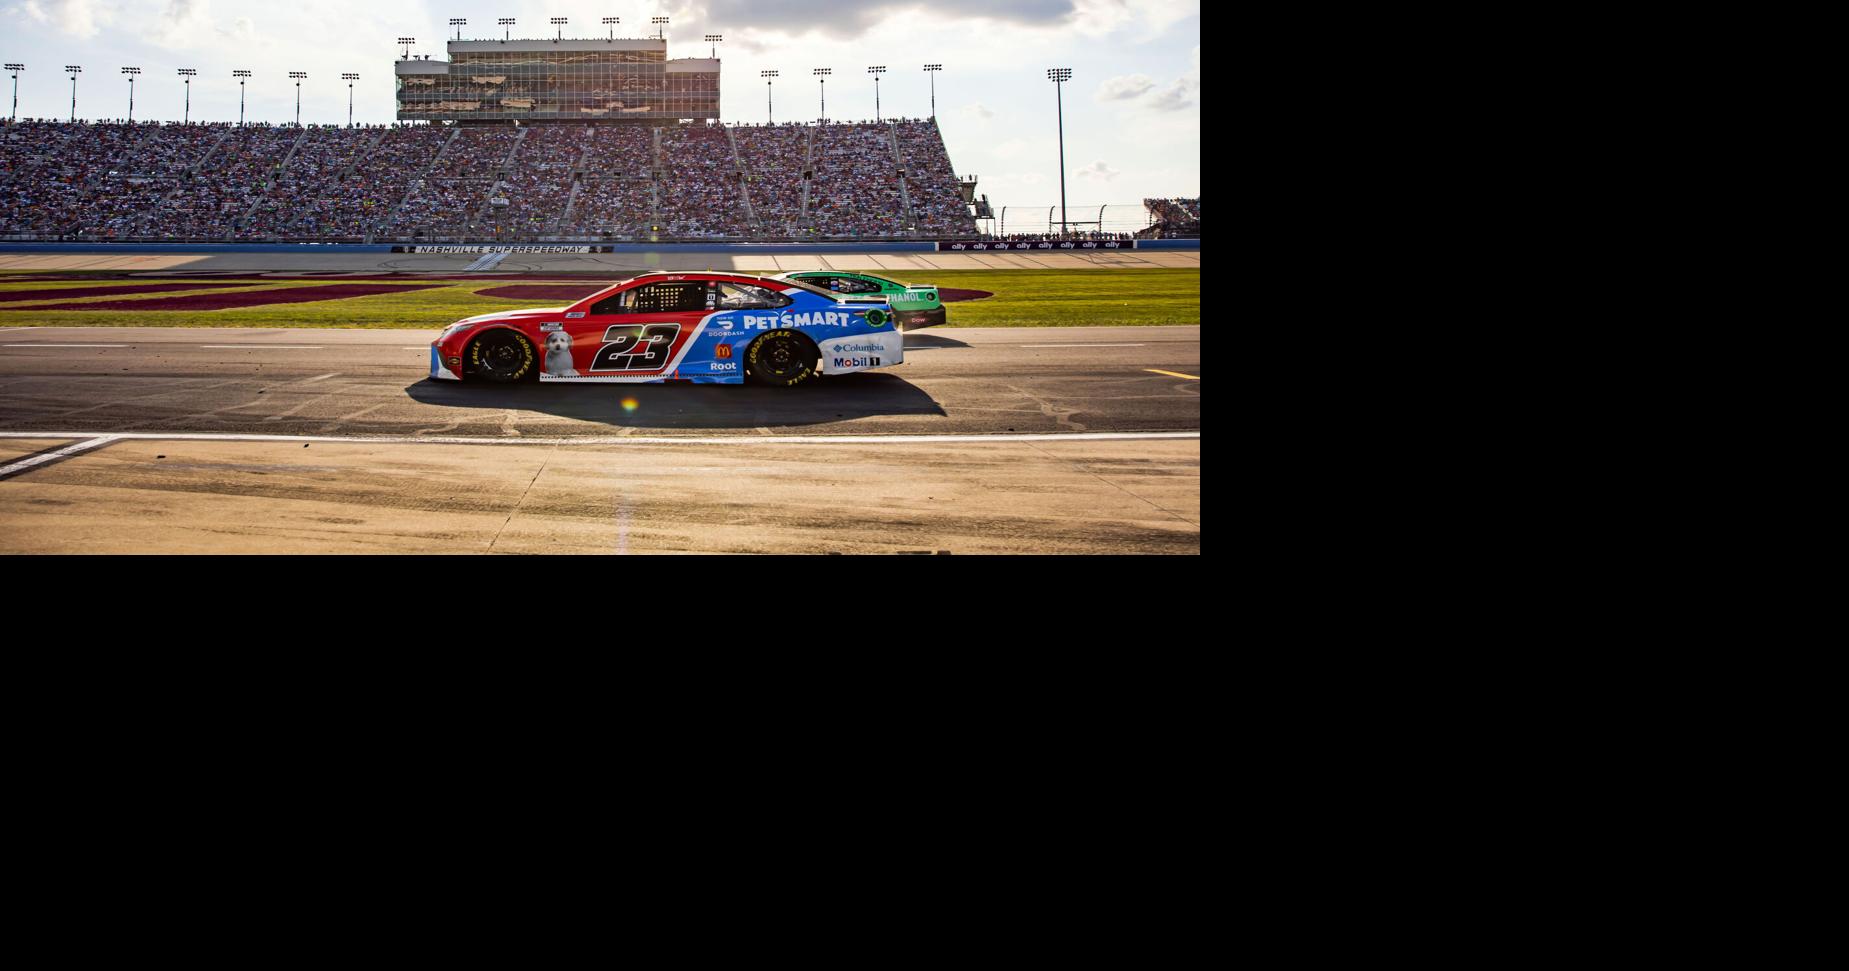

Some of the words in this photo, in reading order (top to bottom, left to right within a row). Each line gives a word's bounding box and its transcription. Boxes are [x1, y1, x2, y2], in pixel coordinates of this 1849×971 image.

[420, 246, 485, 254] NASHVILLE
[1082, 241, 1098, 249] ally
[1105, 241, 1120, 249] ally
[589, 322, 681, 372] 23
[749, 330, 792, 364] GOODYEAR
[843, 343, 884, 352] Columbia
[472, 341, 481, 365] EAGLE
[515, 335, 533, 380] GOODYEAR
[710, 362, 737, 370] Root
[834, 357, 867, 367] Mobil
